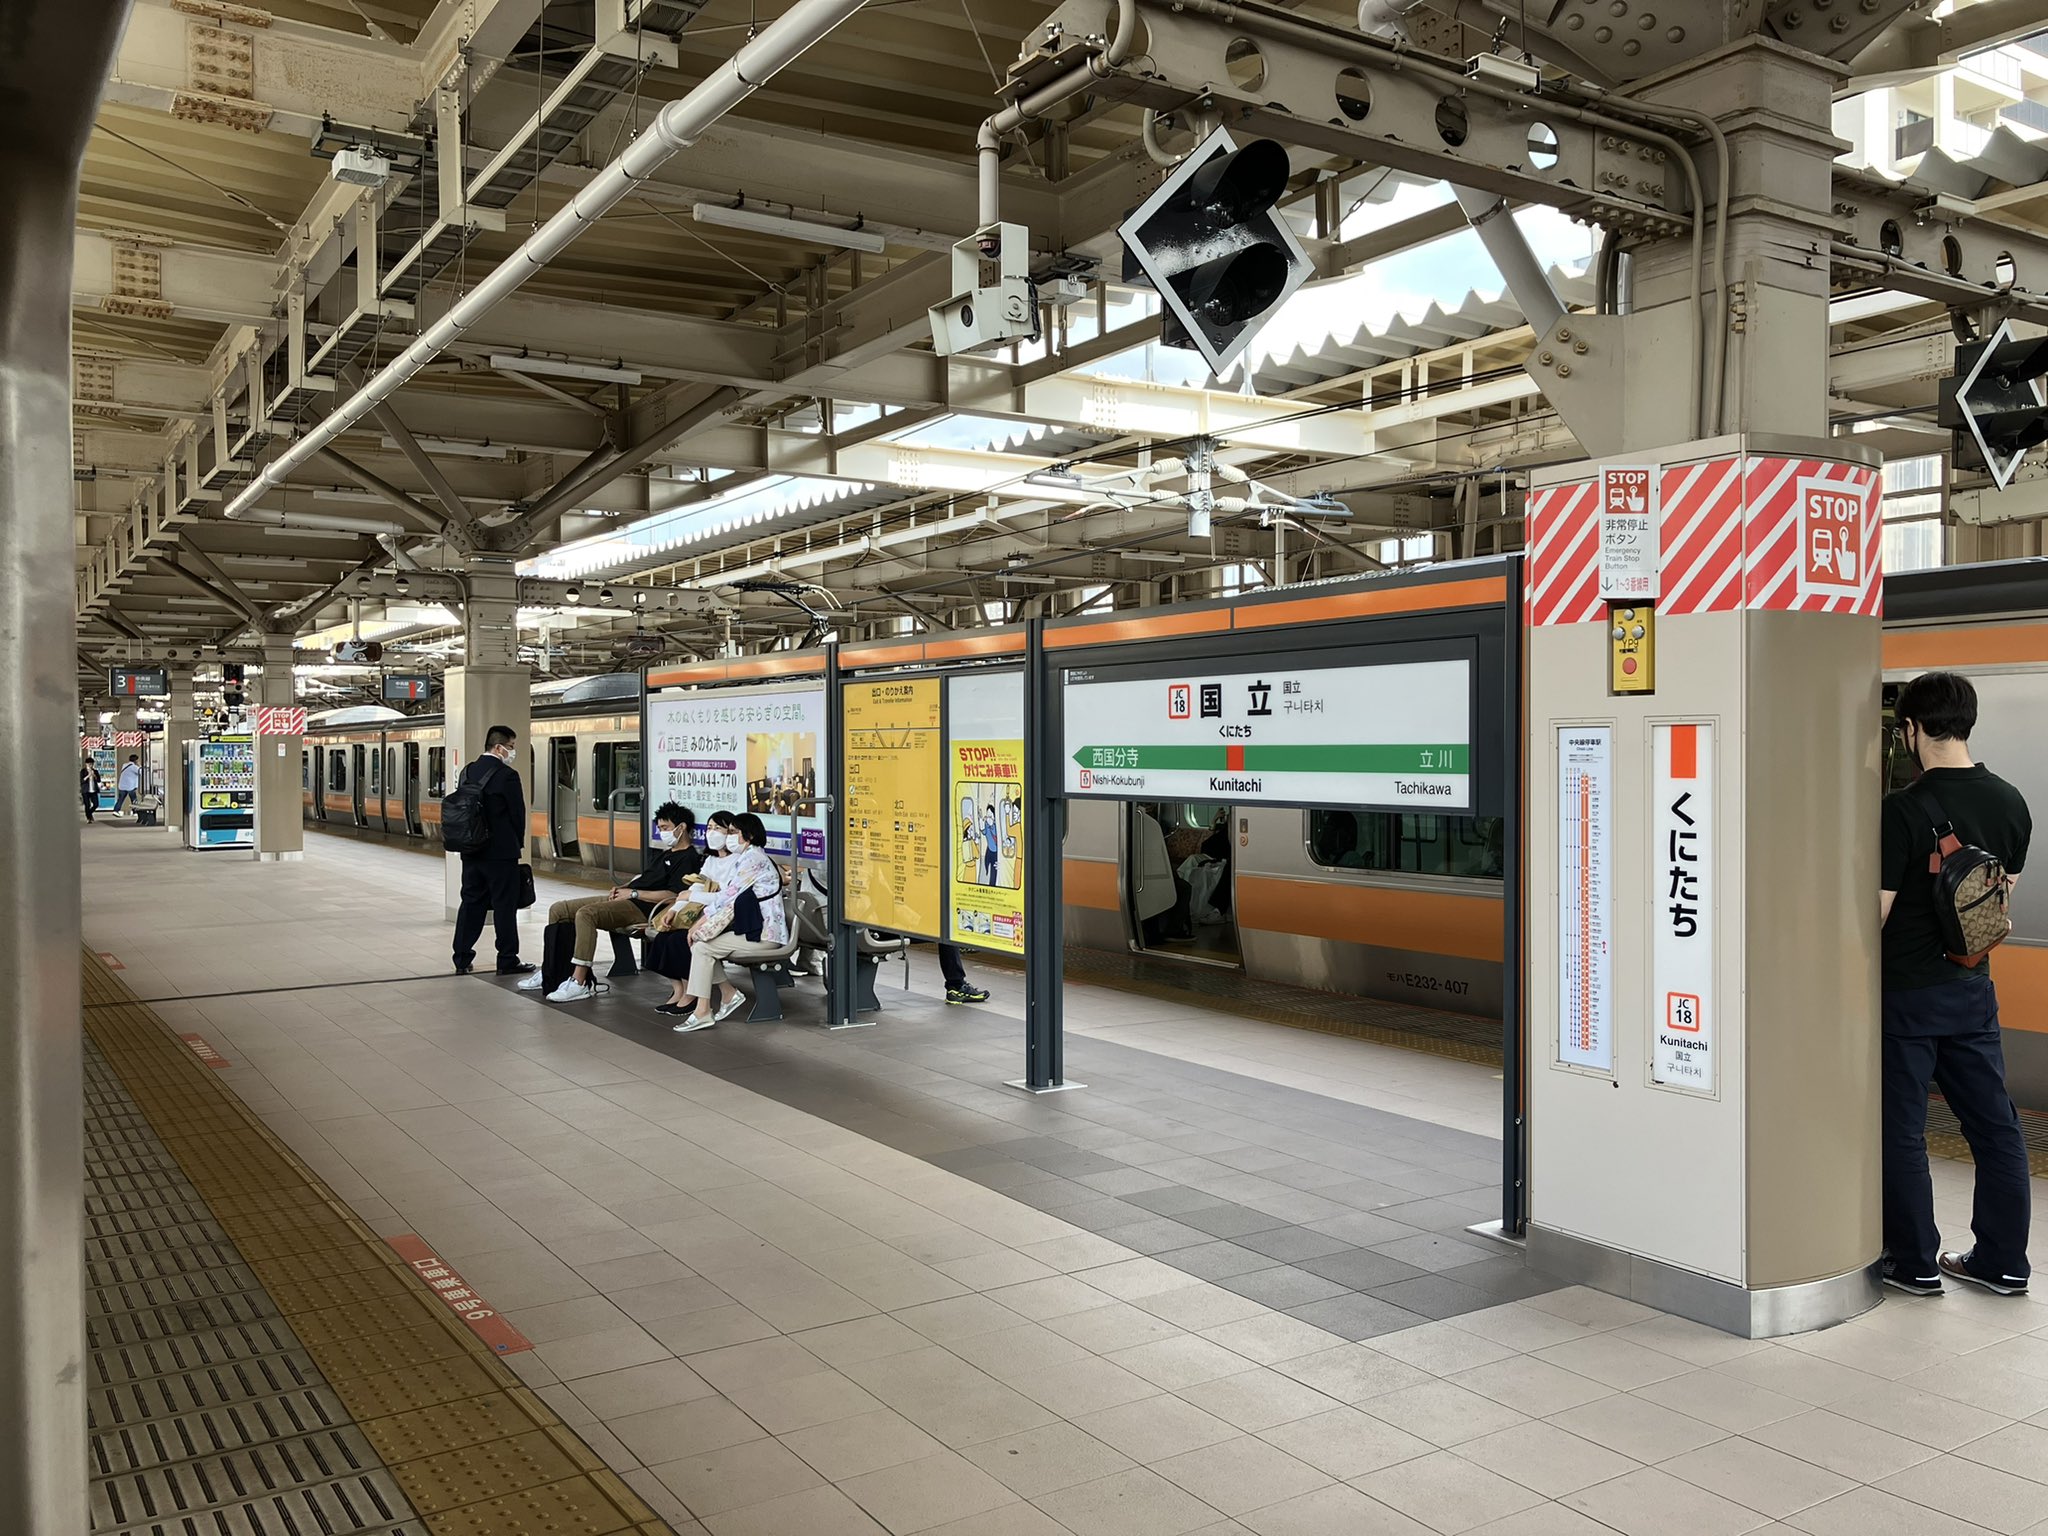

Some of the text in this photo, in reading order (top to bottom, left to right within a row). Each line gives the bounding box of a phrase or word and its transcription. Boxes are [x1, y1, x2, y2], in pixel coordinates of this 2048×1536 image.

[1608, 472, 1646, 484] STOP
[1809, 494, 1858, 523] STOP
[1605, 519, 1648, 531] 非常停止
[1605, 534, 1637, 545] ボタン
[1605, 547, 1641, 555] Emergency
[1624, 555, 1640, 563] Stop
[117, 675, 126, 688] 3
[416, 681, 424, 692] 2
[1283, 681, 1301, 694] 国立
[1175, 689, 1183, 699] JC
[1200, 680, 1272, 718] 国立
[1174, 700, 1185, 713] 18
[1283, 699, 1324, 714] 구니타치
[1219, 725, 1252, 738] くにたち
[690, 734, 738, 752] みのわホール
[959, 747, 997, 761] STOP!!
[1092, 748, 1139, 767] 西国分寺
[1419, 749, 1453, 768] 立川
[1092, 774, 1145, 789] Nishi-Kokubunji
[1209, 776, 1262, 792] Kunitachi
[1394, 780, 1452, 795] Tachikawa
[1669, 792, 1698, 937] くにたち
[1677, 998, 1690, 1010] JC
[1675, 1009, 1693, 1024] 18
[1660, 1034, 1708, 1052] Kunitachi
[1675, 1051, 1691, 1062] 国立
[1666, 1062, 1702, 1078] 구니타치
